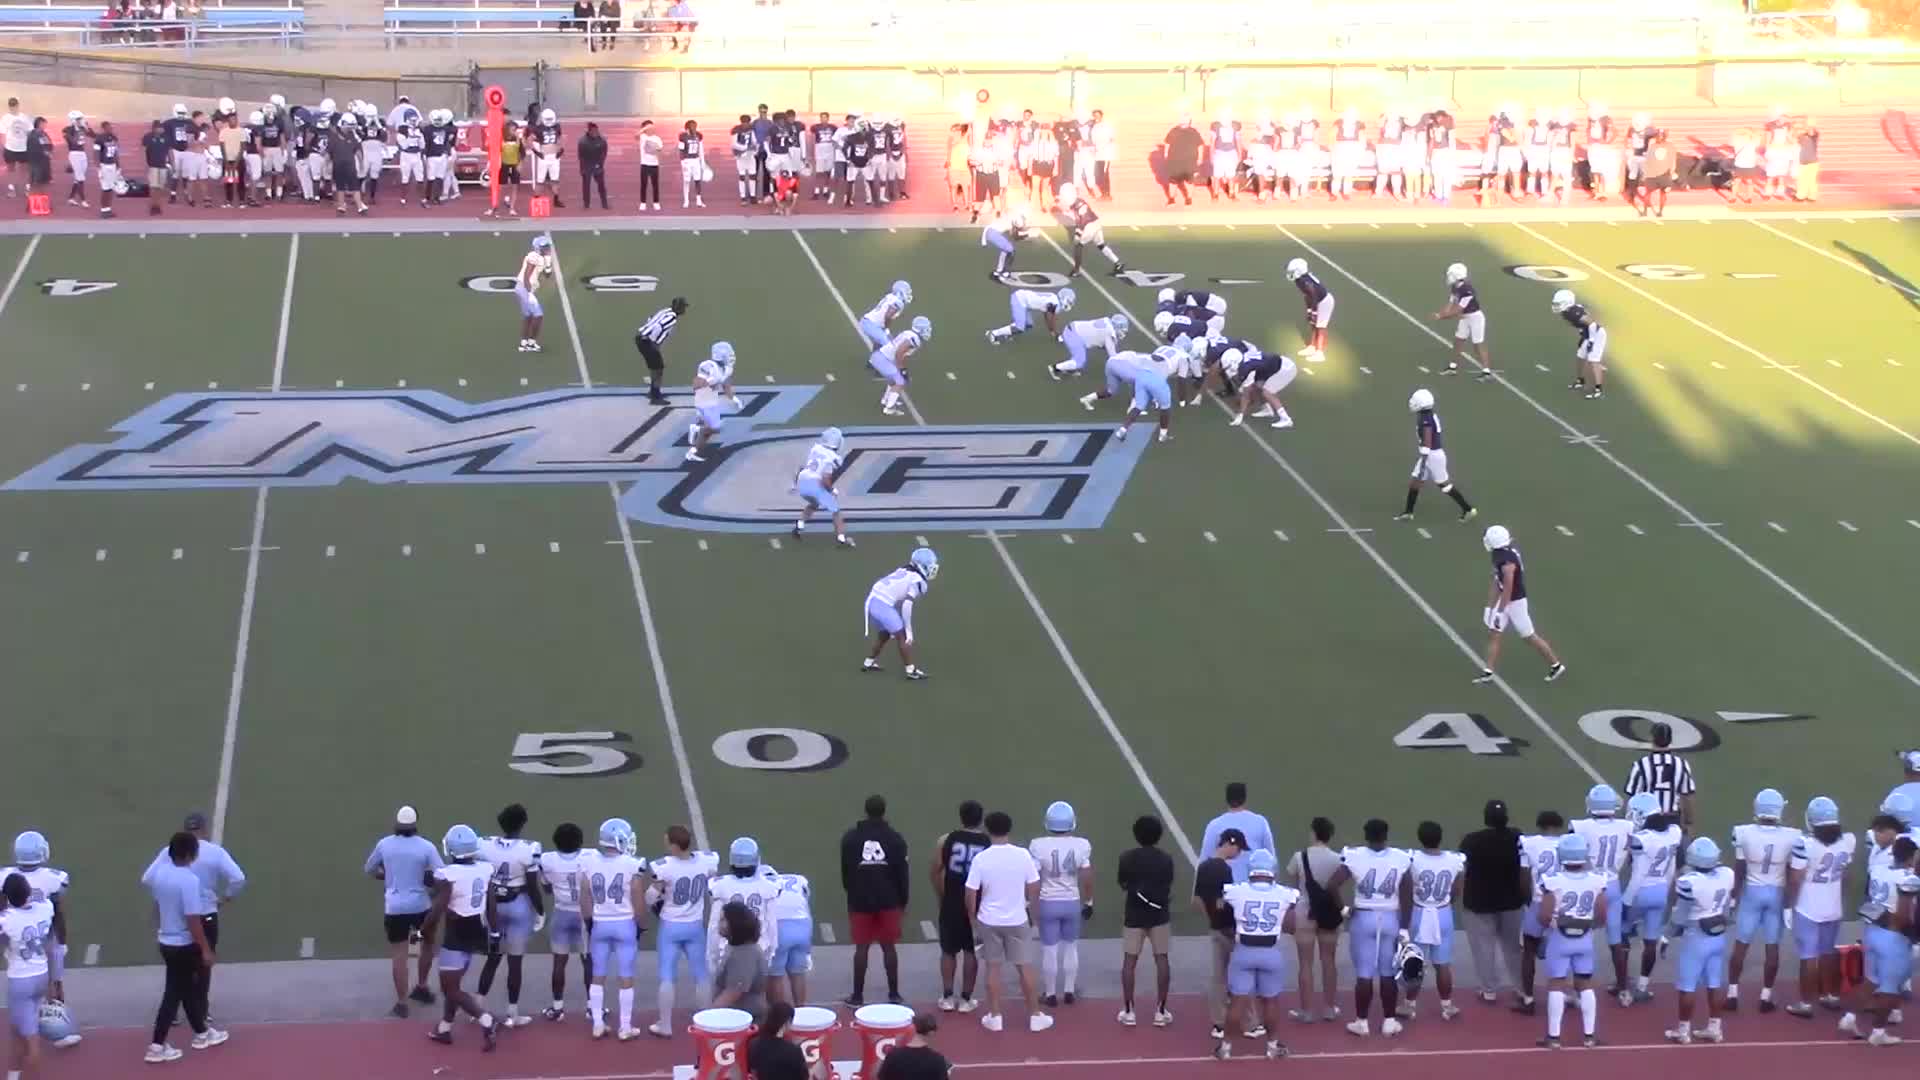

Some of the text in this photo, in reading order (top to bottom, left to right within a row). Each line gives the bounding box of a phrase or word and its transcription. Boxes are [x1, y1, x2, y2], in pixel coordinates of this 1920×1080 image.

[1655, 763, 1674, 790] L
[1051, 848, 1076, 878] 14
[1595, 834, 1618, 868] 11
[1358, 867, 1399, 900] 44
[1418, 869, 1453, 902] 30
[1243, 900, 1281, 933] 55
[714, 1042, 736, 1066] G
[801, 1039, 821, 1063] G
